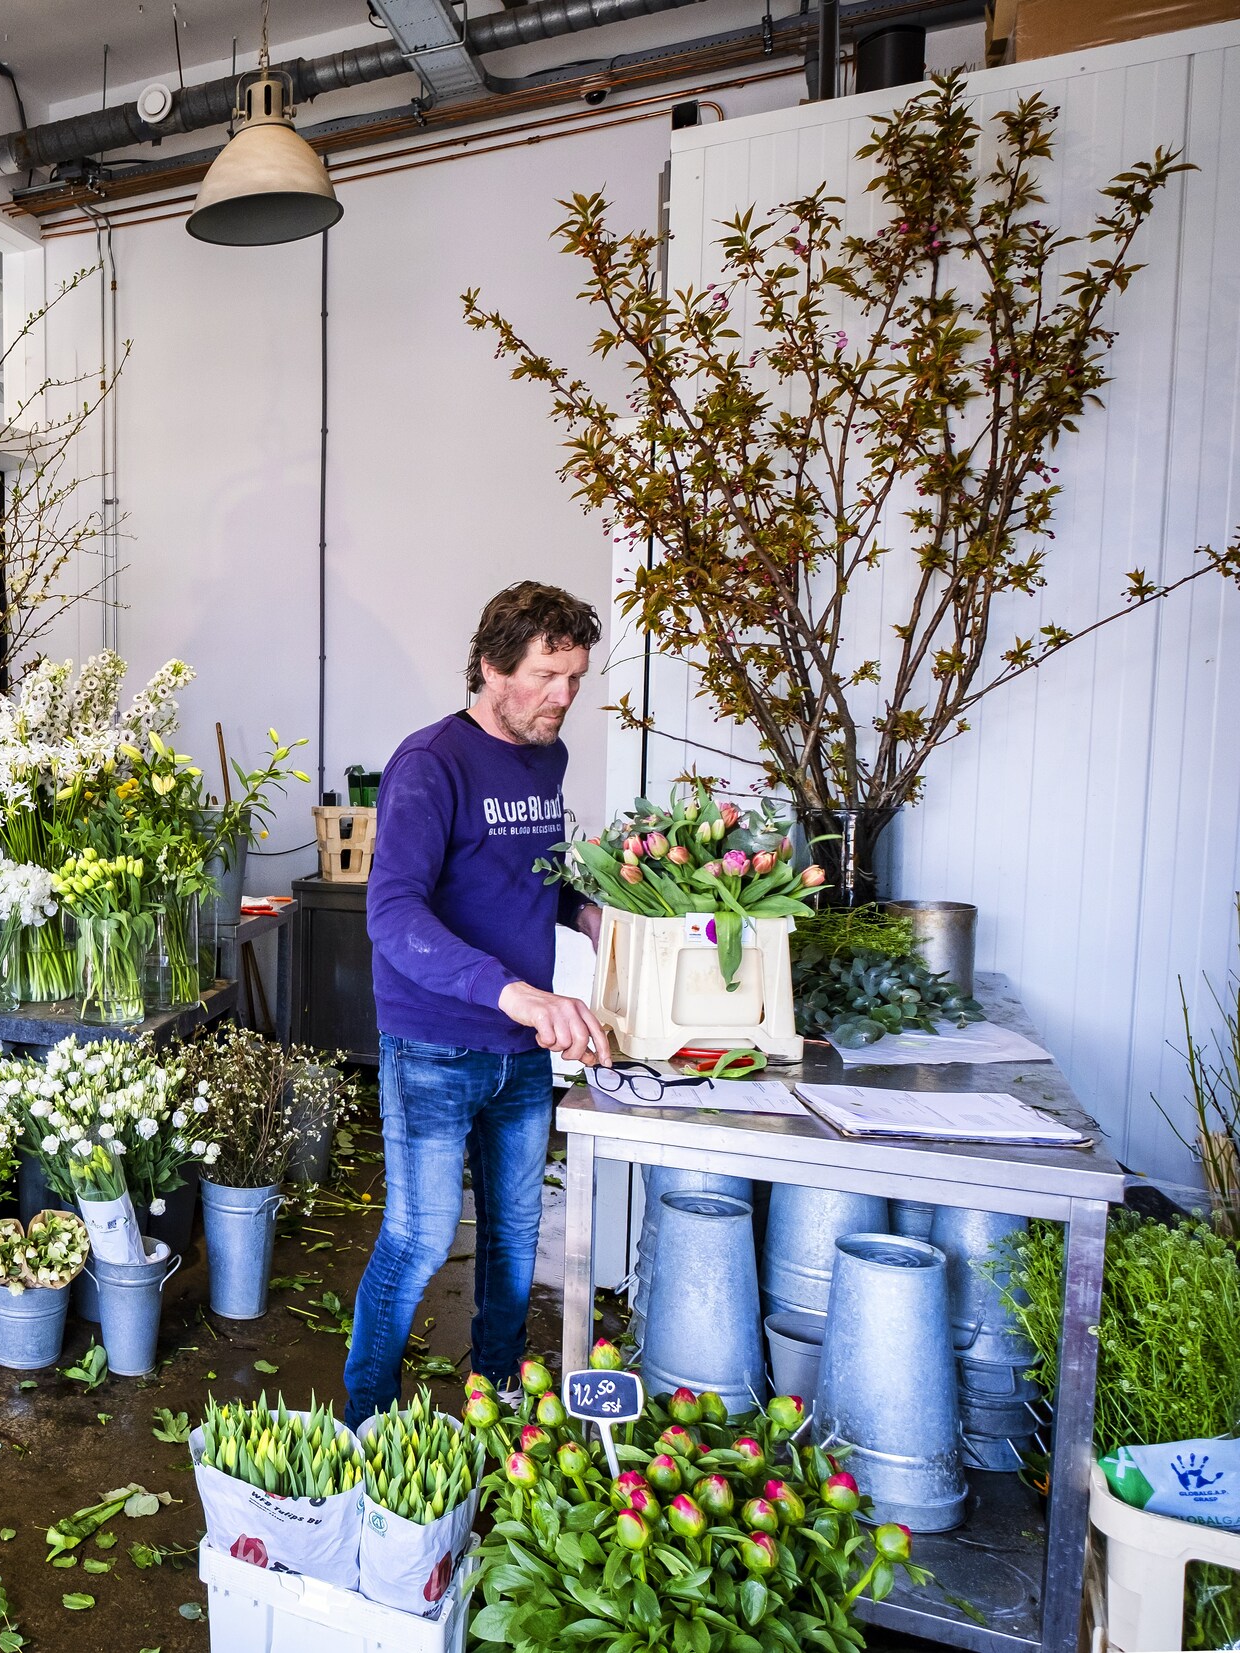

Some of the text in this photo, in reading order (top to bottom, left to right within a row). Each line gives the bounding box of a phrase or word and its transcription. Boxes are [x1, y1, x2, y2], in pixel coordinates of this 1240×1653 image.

[488, 827, 507, 836] BLUE
[510, 826, 531, 835] BLOOD
[251, 1491, 272, 1507] WFB
[274, 1506, 305, 1522] Tulips
[306, 1517, 323, 1526] BV
